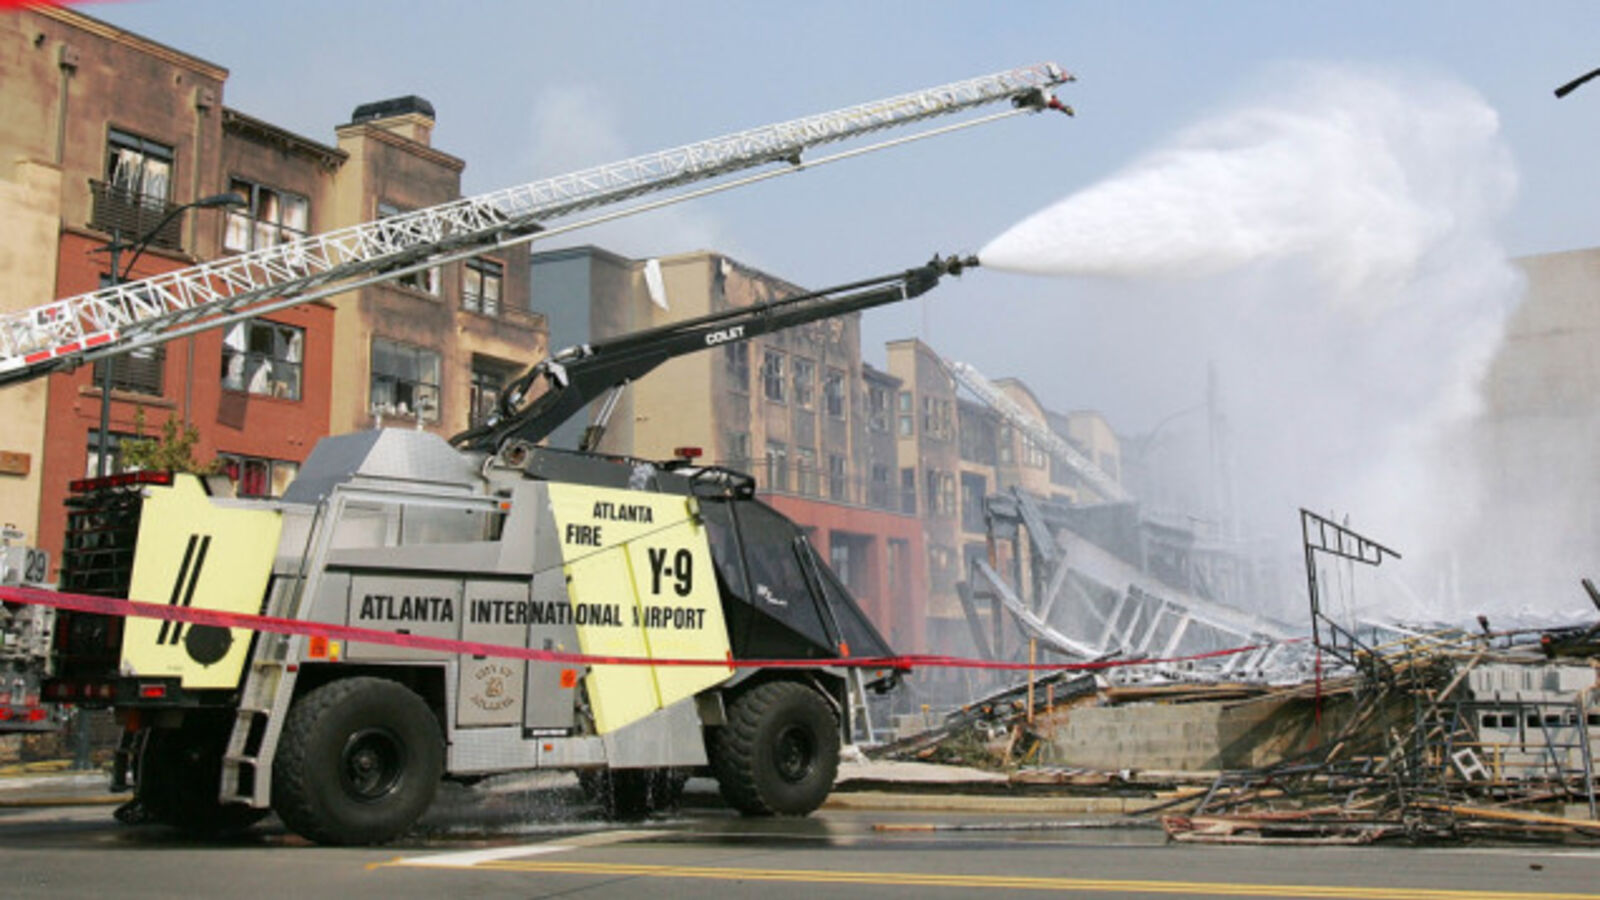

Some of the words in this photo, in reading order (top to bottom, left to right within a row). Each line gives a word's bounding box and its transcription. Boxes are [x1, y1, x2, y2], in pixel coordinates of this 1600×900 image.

[705, 325, 744, 345] COLET
[592, 501, 653, 523] ATLANTA
[565, 523, 602, 546] FIRE
[25, 549, 46, 583] 29
[648, 547, 693, 597] Y-9
[360, 595, 454, 622] ATLANTA
[470, 599, 622, 627] INTERNATIONAL
